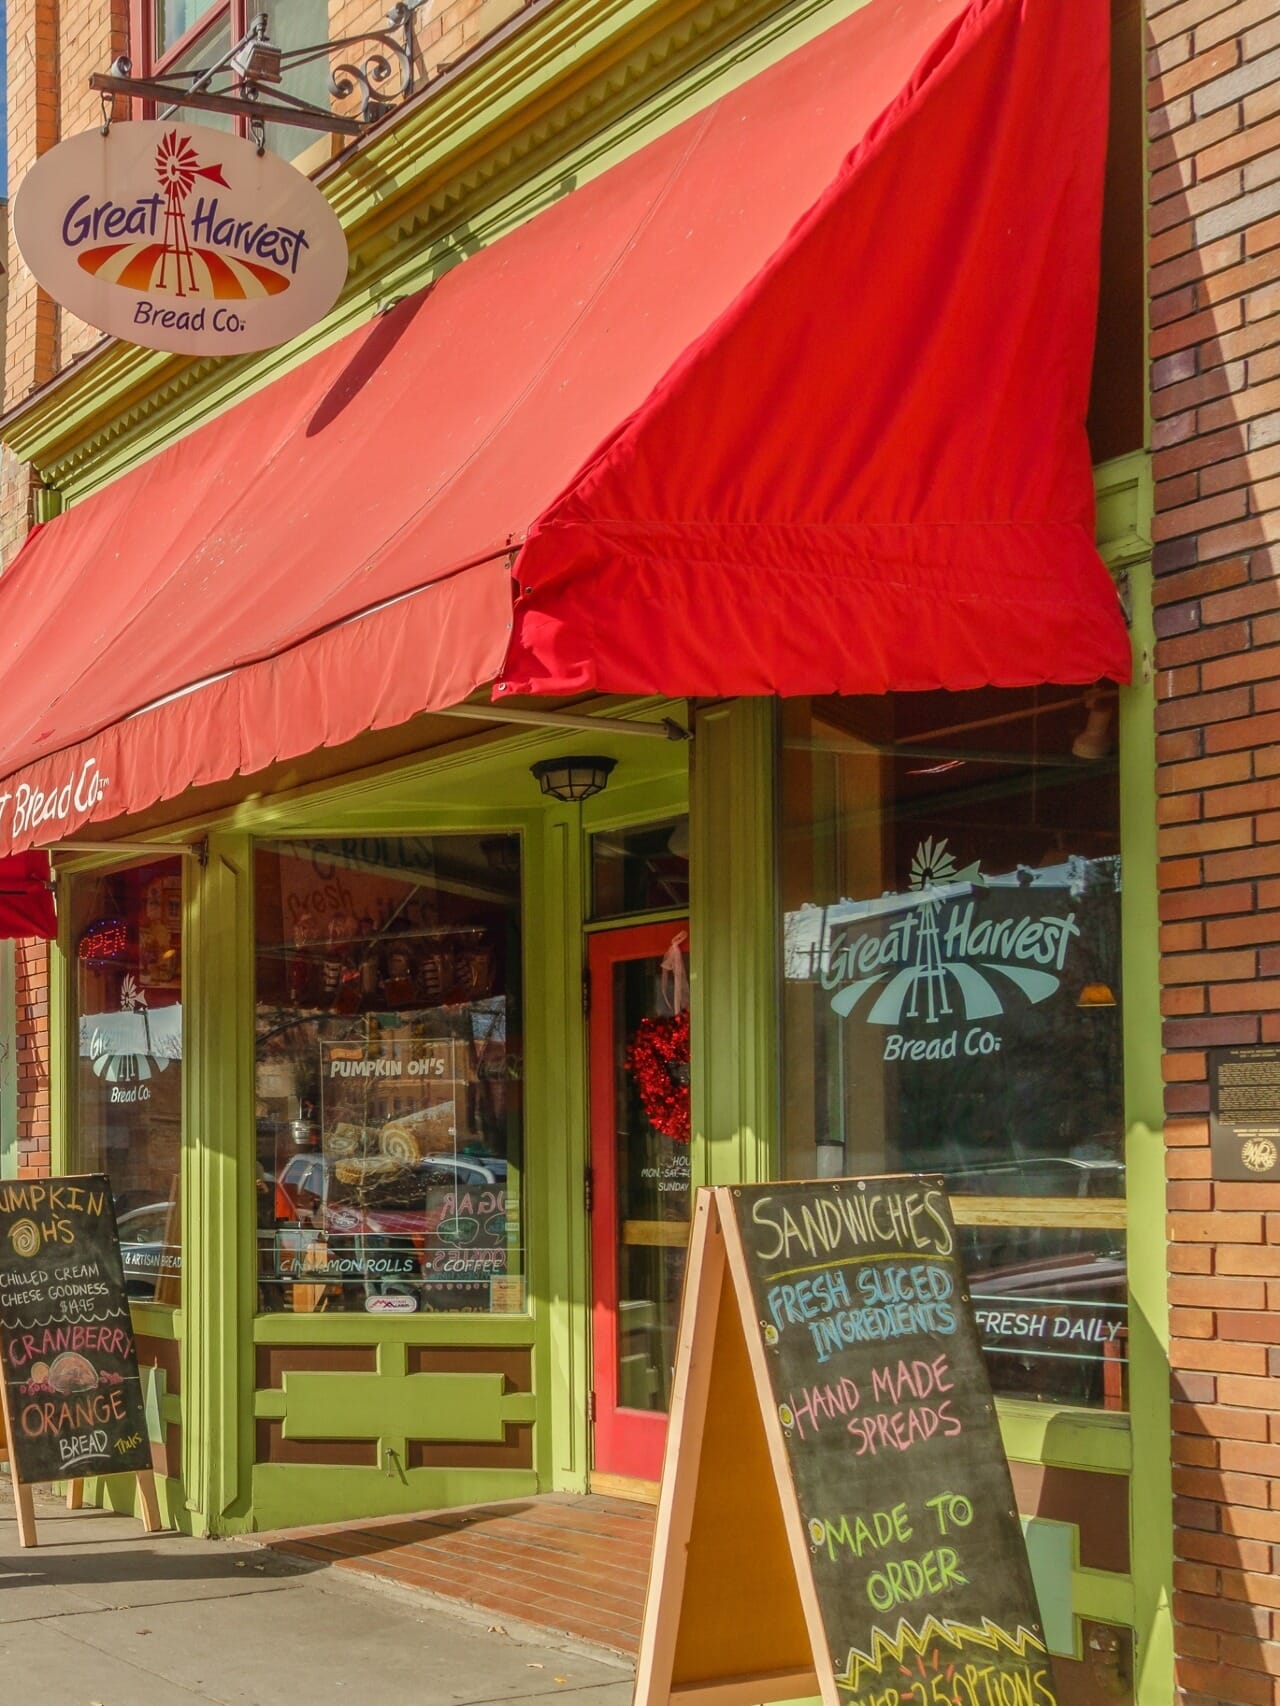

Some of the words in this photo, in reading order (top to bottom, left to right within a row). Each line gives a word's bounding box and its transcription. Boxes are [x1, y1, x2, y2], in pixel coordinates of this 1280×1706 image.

[62, 193, 165, 246] Great
[191, 198, 309, 274] Harvest
[134, 301, 205, 331] Bread
[213, 308, 245, 332] Co.
[12, 771, 74, 838] Bread
[74, 757, 103, 812] Co.
[80, 925, 127, 960] OPEN
[821, 912, 918, 990] Great
[944, 902, 1081, 970] Harvest
[883, 1030, 957, 1061] Bread
[964, 1027, 1001, 1057] Co.
[330, 1060, 402, 1079] PUMPKIN
[407, 1058, 445, 1076] OH'S
[111, 1085, 137, 1103] Bread
[658, 1182, 689, 1192] SUNDAY
[752, 1190, 953, 1260] SANDWICHES
[54, 1262, 100, 1281] CREAM
[131, 1253, 161, 1266] ARTISAN
[366, 1258, 413, 1272] ROLLS
[443, 1259, 502, 1272] COFFEE
[1, 1289, 44, 1307] CHEESE
[47, 1282, 110, 1300] GOODNESS
[768, 1269, 851, 1332] FRESH
[856, 1265, 953, 1306] SLICED
[808, 1302, 957, 1363] INGREDIENTS
[975, 1311, 1047, 1337] FRESH
[1053, 1317, 1122, 1342] DAILY
[8, 1326, 133, 1369] CRANBERRY
[22, 1390, 126, 1437] ORANGE
[789, 1376, 860, 1440] HAND
[871, 1353, 955, 1405] MADE
[59, 1430, 108, 1460] BREAD
[847, 1400, 962, 1456] SPREADS
[824, 1502, 913, 1561] MADE
[926, 1492, 974, 1536] TO
[866, 1546, 970, 1613] ORDER
